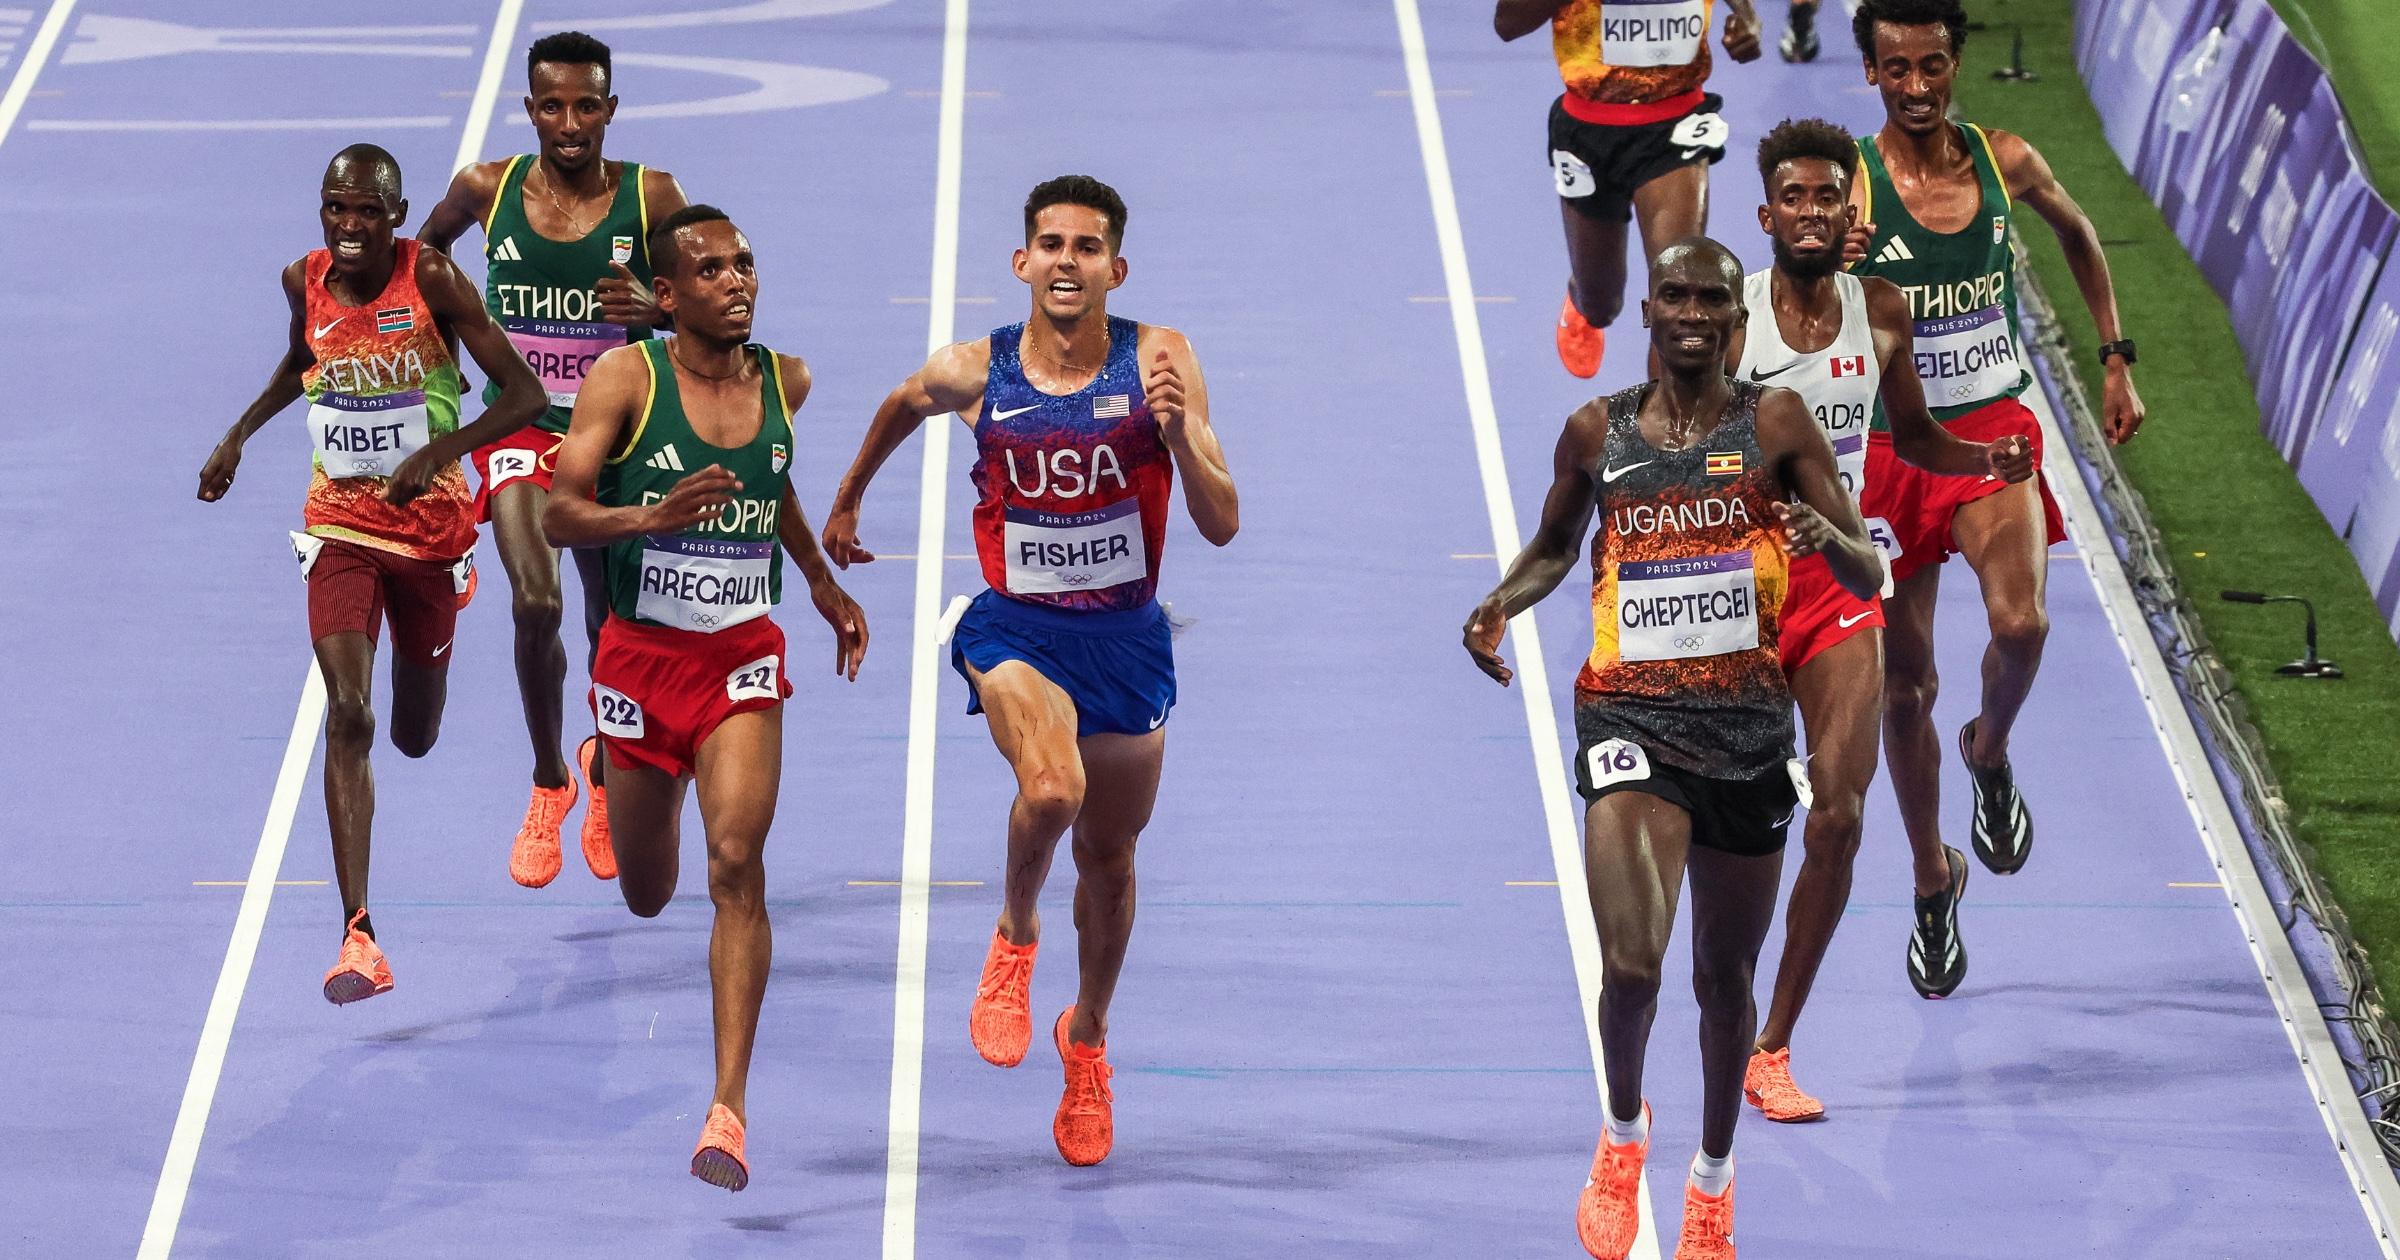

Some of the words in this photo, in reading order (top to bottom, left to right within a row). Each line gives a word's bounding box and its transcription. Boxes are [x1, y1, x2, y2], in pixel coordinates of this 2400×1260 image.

[1604, 14, 1703, 42] KIPLIMO
[1692, 121, 1710, 138] 5
[1560, 161, 1575, 186] 5
[498, 284, 603, 321] ETHIOP
[1901, 271, 2004, 319] THIOPIA
[535, 324, 566, 334] PARIS
[569, 327, 598, 335] 2024
[1923, 322, 1955, 334] PARIS
[320, 349, 426, 392] KENYA
[1913, 335, 2013, 379] EJELCHA
[334, 396, 359, 408] PARIS
[362, 399, 391, 408] 2024
[1815, 403, 1864, 430] ADA
[324, 423, 405, 452] KIBET
[494, 456, 524, 475] 12
[1005, 444, 1127, 498] USA
[1039, 514, 1072, 525] PARIS
[1076, 513, 1106, 524] 2024
[1614, 497, 1750, 536] UGANDA
[681, 542, 715, 553] PARIS
[719, 545, 747, 555] 2024
[1020, 534, 1130, 567] FISHER
[1646, 564, 1681, 575] PARIS
[1686, 560, 1717, 571] 2024
[642, 565, 767, 605] AREGAWI
[1622, 586, 1750, 629] CHEPTEGEI
[736, 665, 772, 692] 22
[602, 695, 637, 726] 22
[1598, 747, 1637, 775] 16
